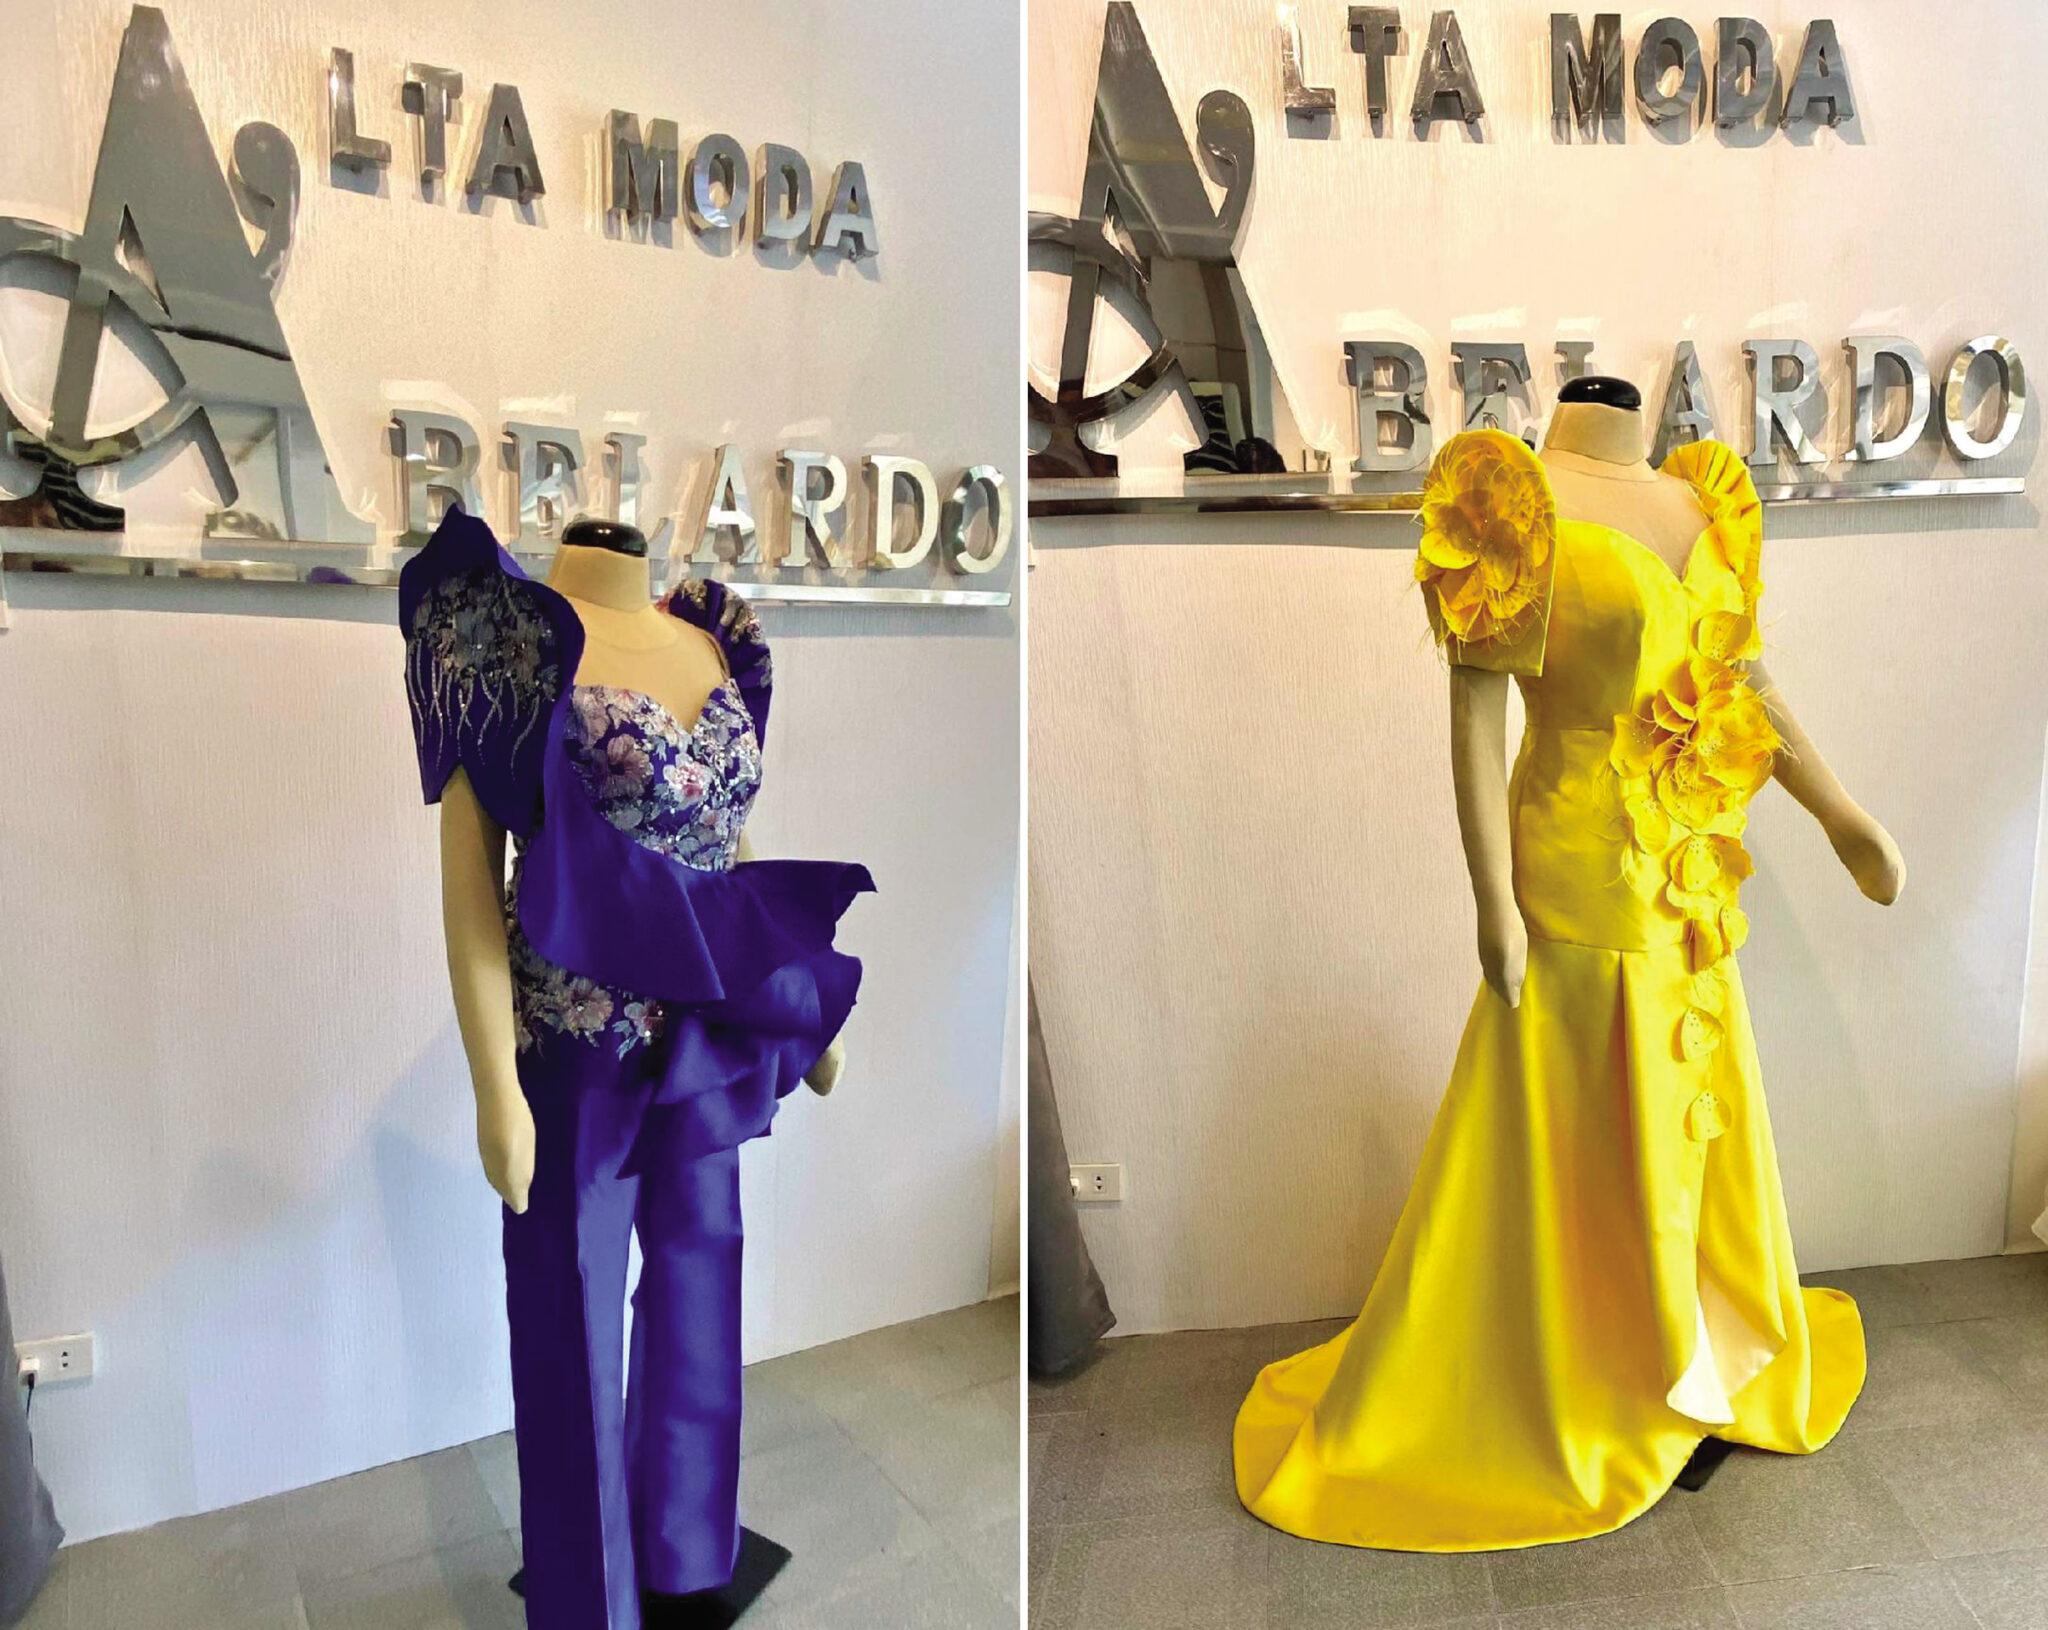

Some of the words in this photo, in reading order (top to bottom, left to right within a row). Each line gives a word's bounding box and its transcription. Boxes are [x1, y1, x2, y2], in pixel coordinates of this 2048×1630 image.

[1550, 13, 1855, 129] MODA
[605, 109, 880, 260] MODA
[1344, 335, 2027, 472] BEARDO
